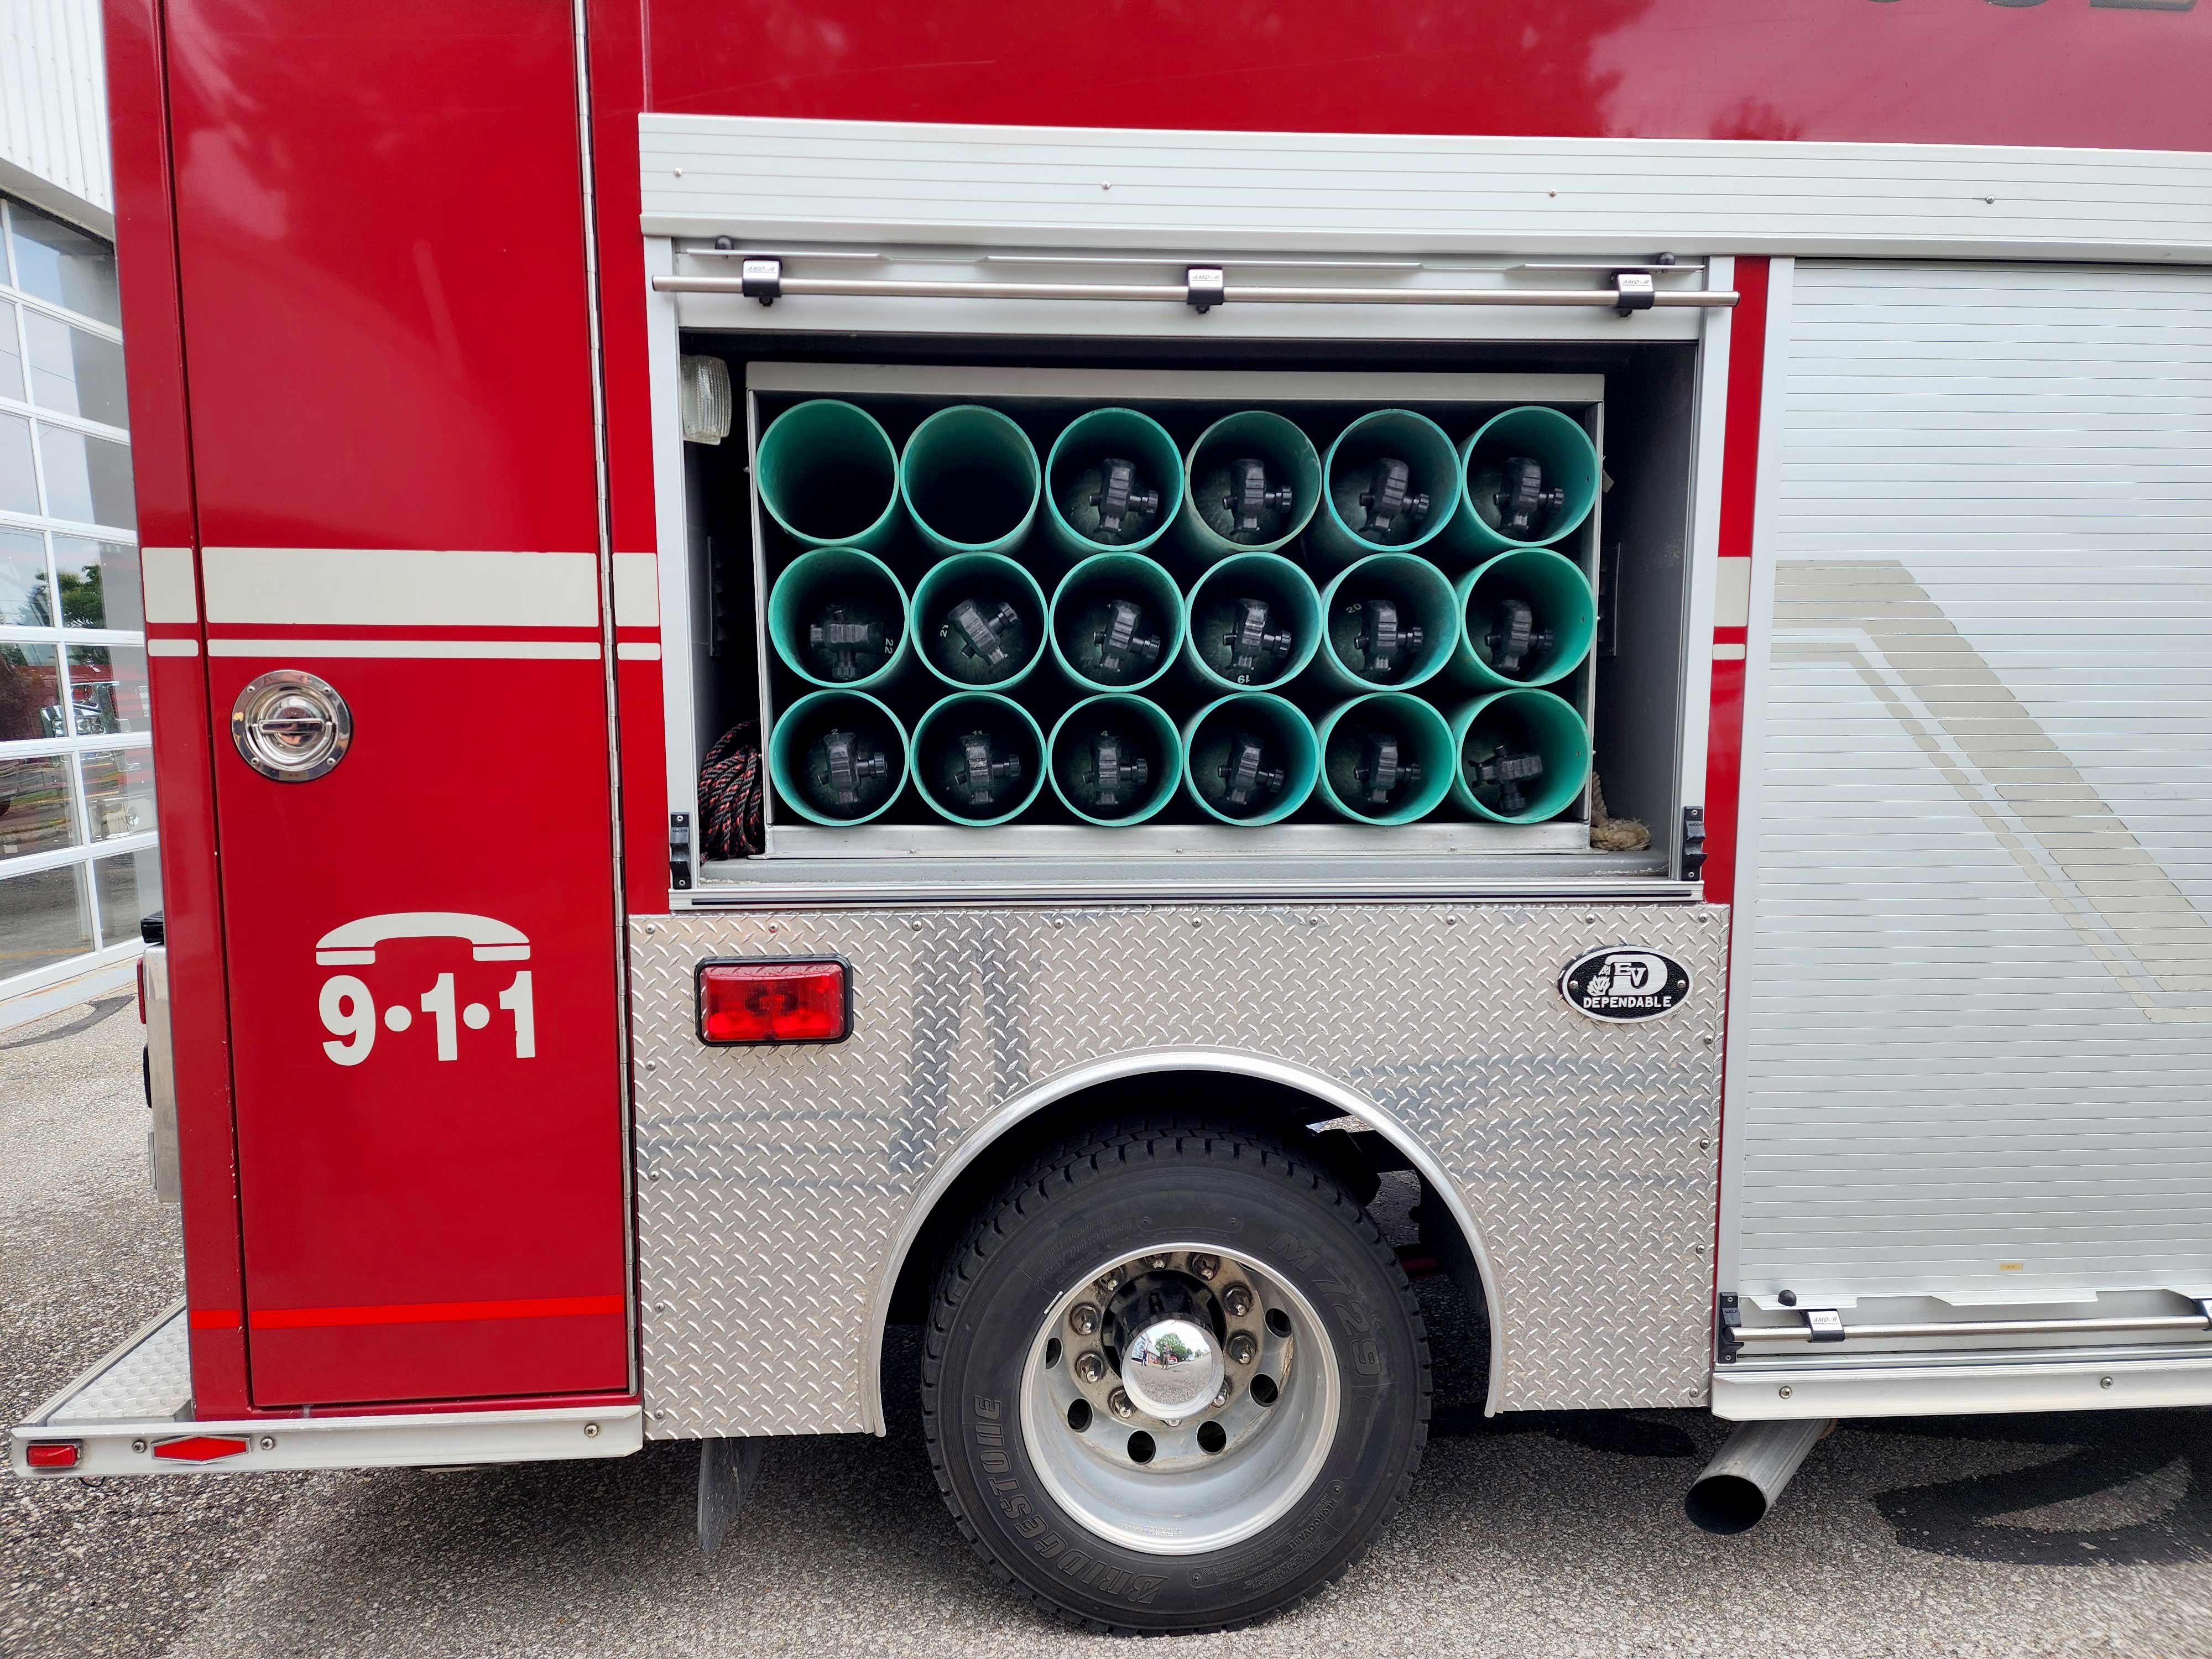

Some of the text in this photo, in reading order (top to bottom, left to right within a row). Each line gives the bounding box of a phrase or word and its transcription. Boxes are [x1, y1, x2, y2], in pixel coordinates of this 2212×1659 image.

[1346, 603, 1362, 614] 20
[884, 638, 894, 655] 22
[1583, 996, 1672, 1008] DEPENDABLE
[974, 1395, 1168, 1604] BRIDGESTONE
